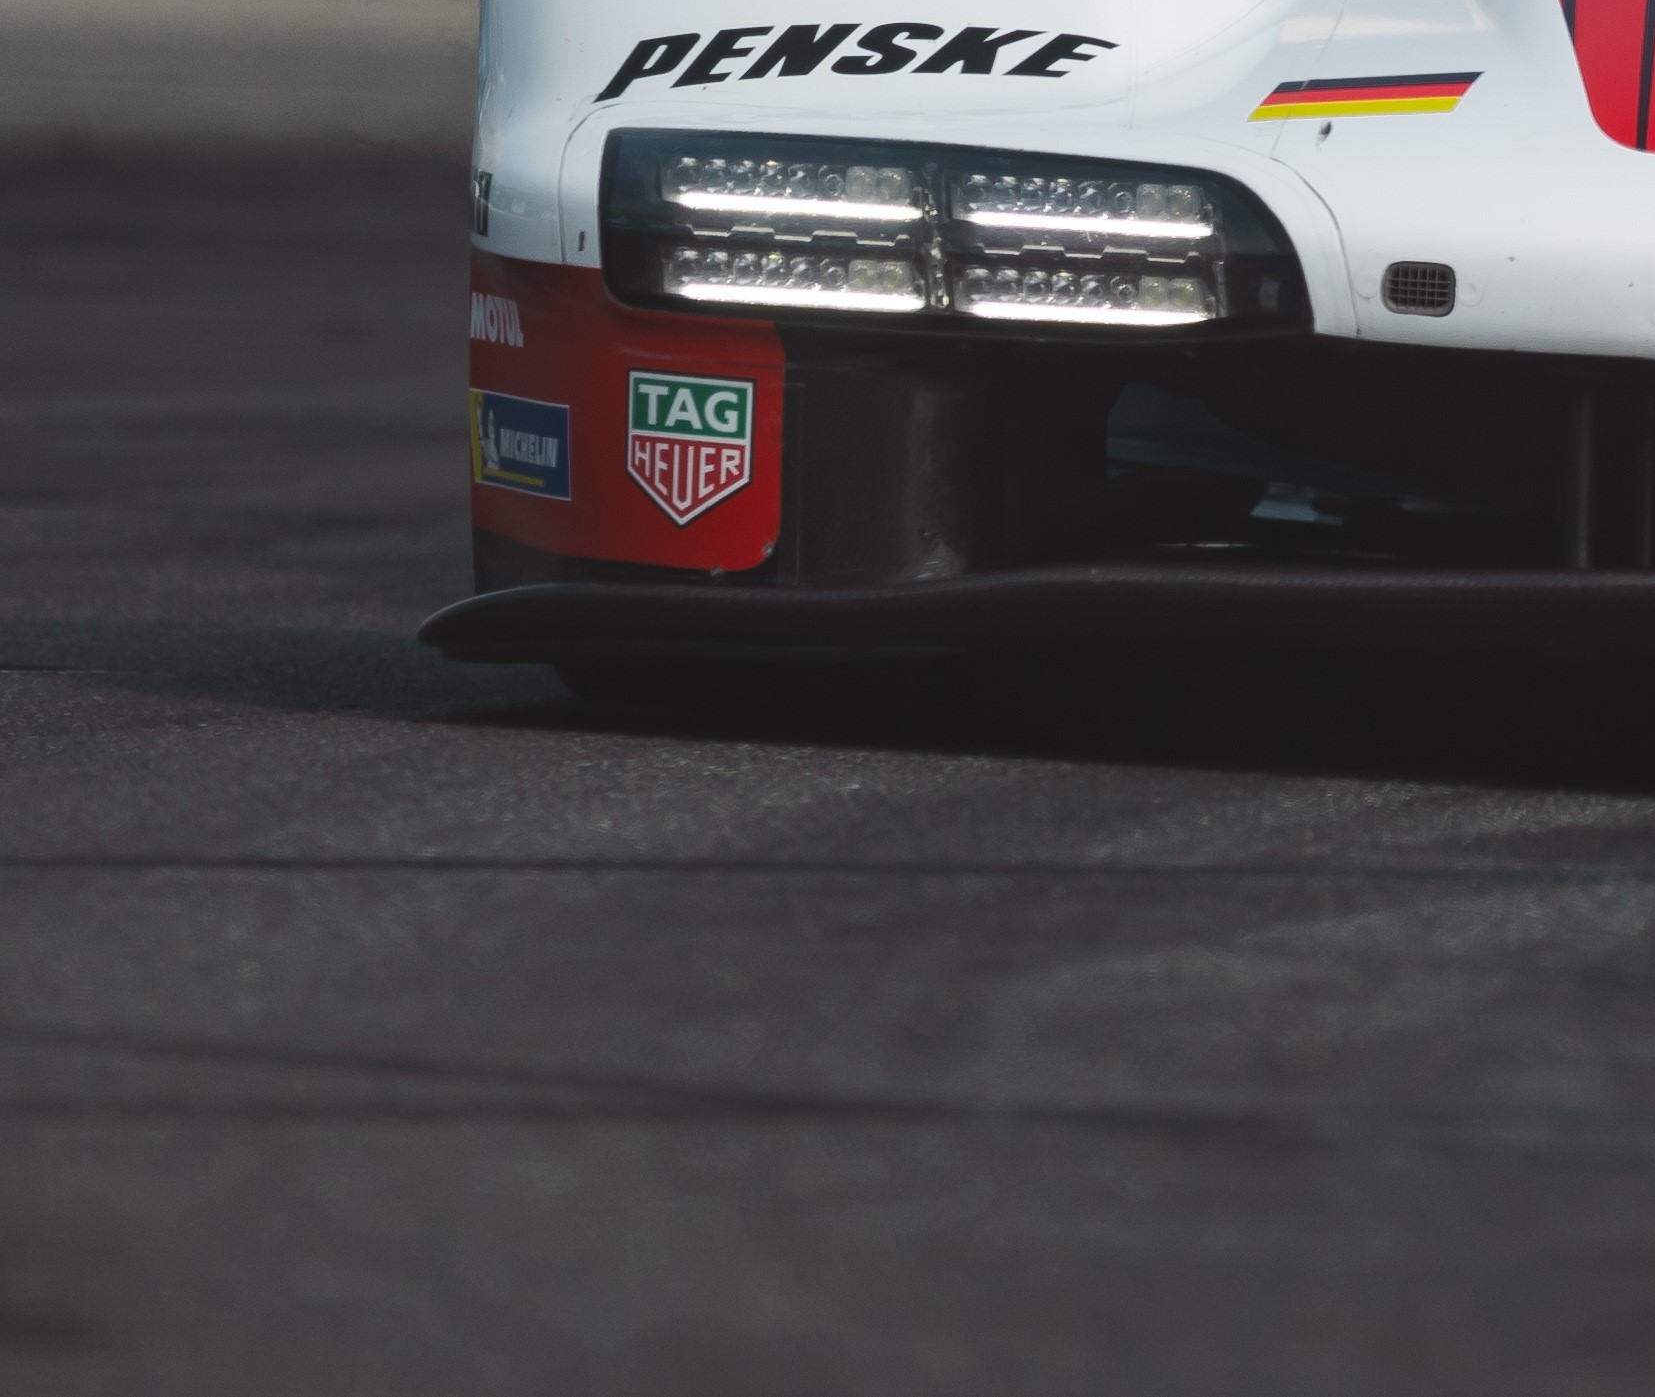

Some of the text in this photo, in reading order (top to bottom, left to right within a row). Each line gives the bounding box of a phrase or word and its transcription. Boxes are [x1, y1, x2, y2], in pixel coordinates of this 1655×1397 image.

[592, 22, 1121, 103] PENSKE
[470, 291, 524, 348] MOTUL
[637, 383, 740, 434] TAG
[499, 426, 560, 468] MICHELIN
[633, 441, 742, 511] HEUER
